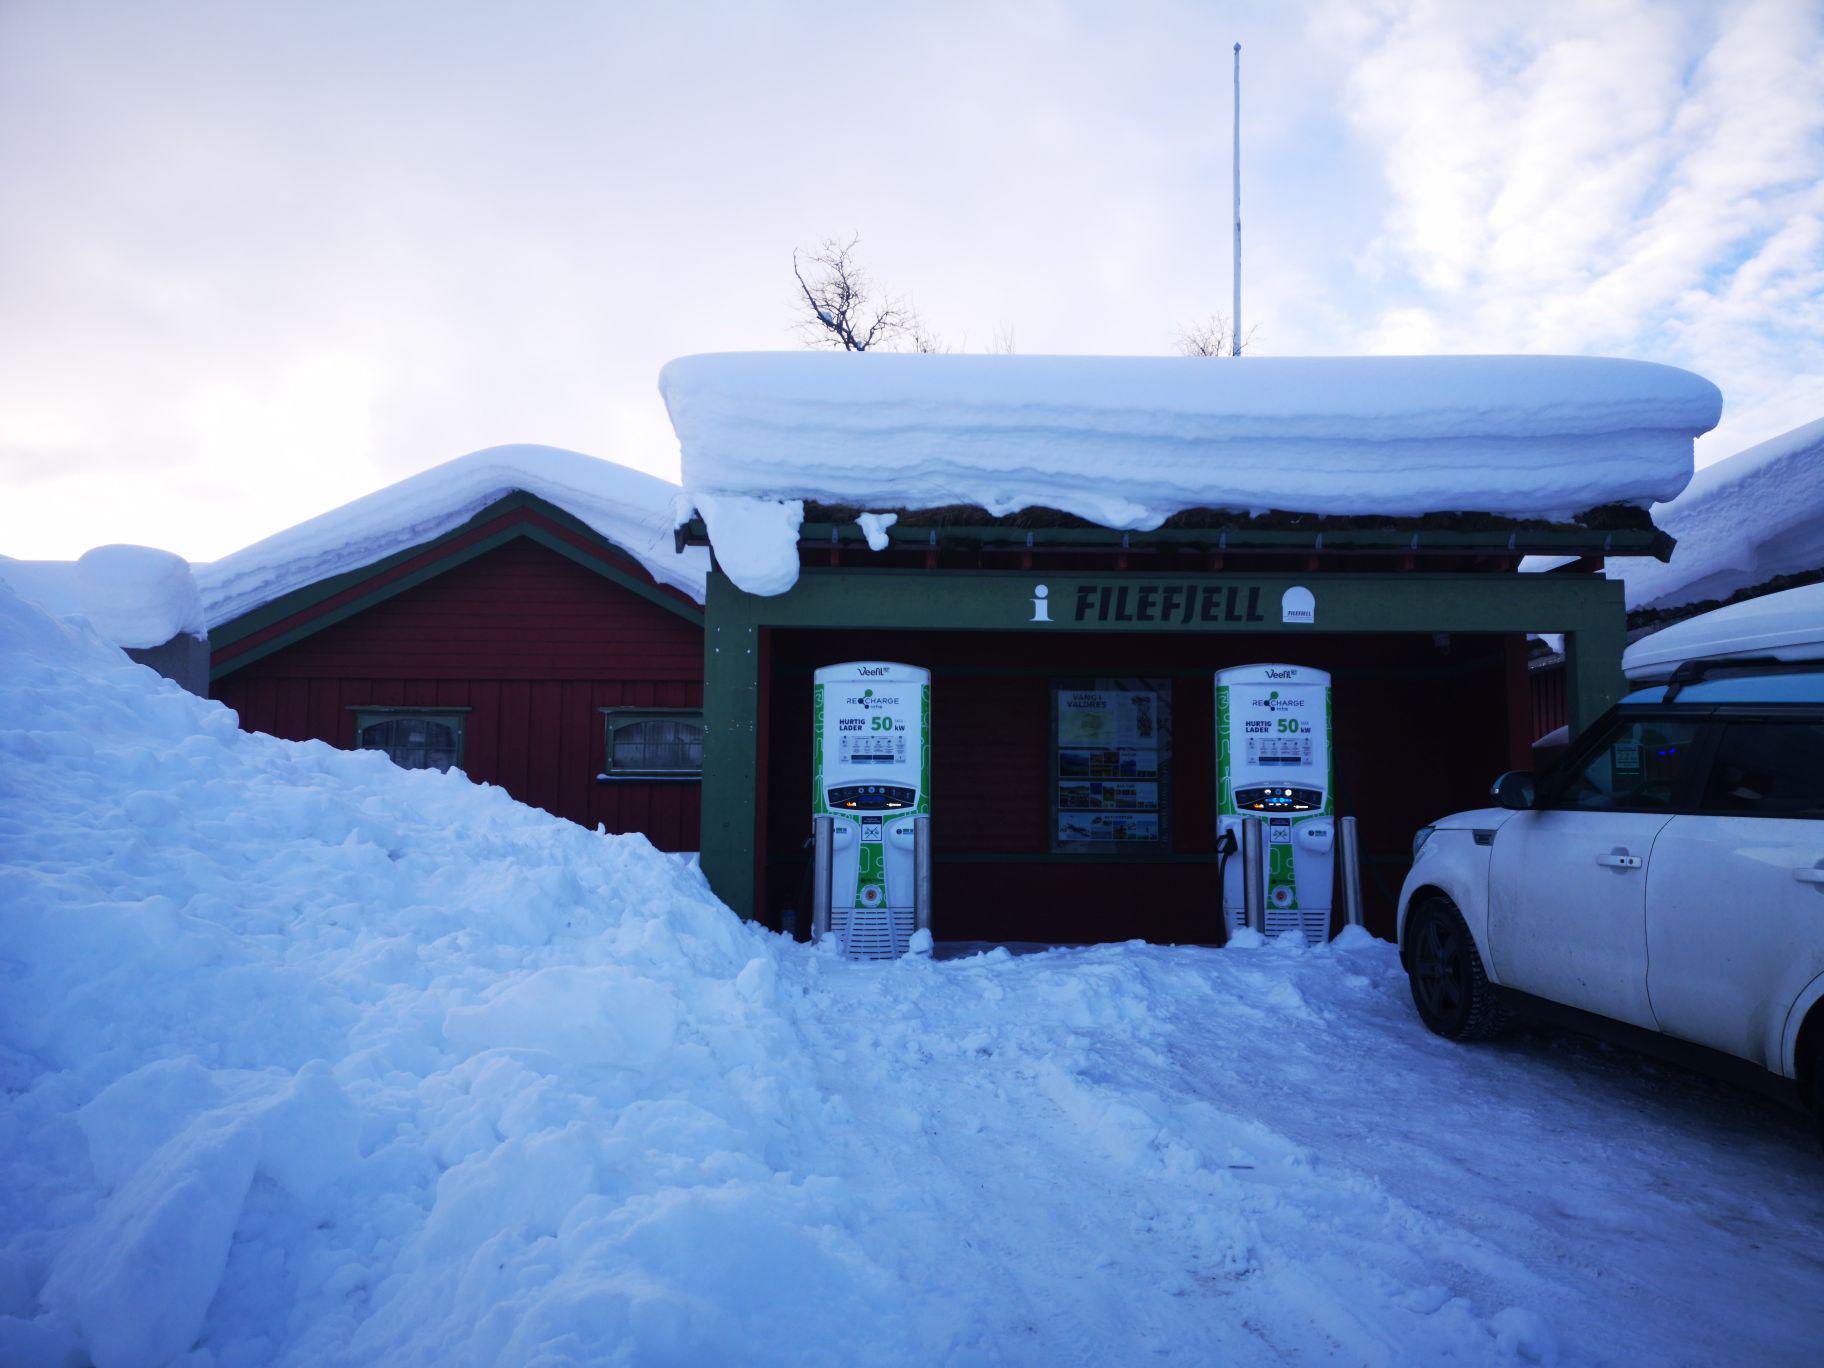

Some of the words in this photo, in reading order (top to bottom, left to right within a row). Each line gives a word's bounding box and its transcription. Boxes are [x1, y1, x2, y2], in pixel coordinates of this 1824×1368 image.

[1074, 585, 1264, 624] FILEFJELL
[871, 716, 893, 732] 50
[1277, 718, 1299, 733] 50
